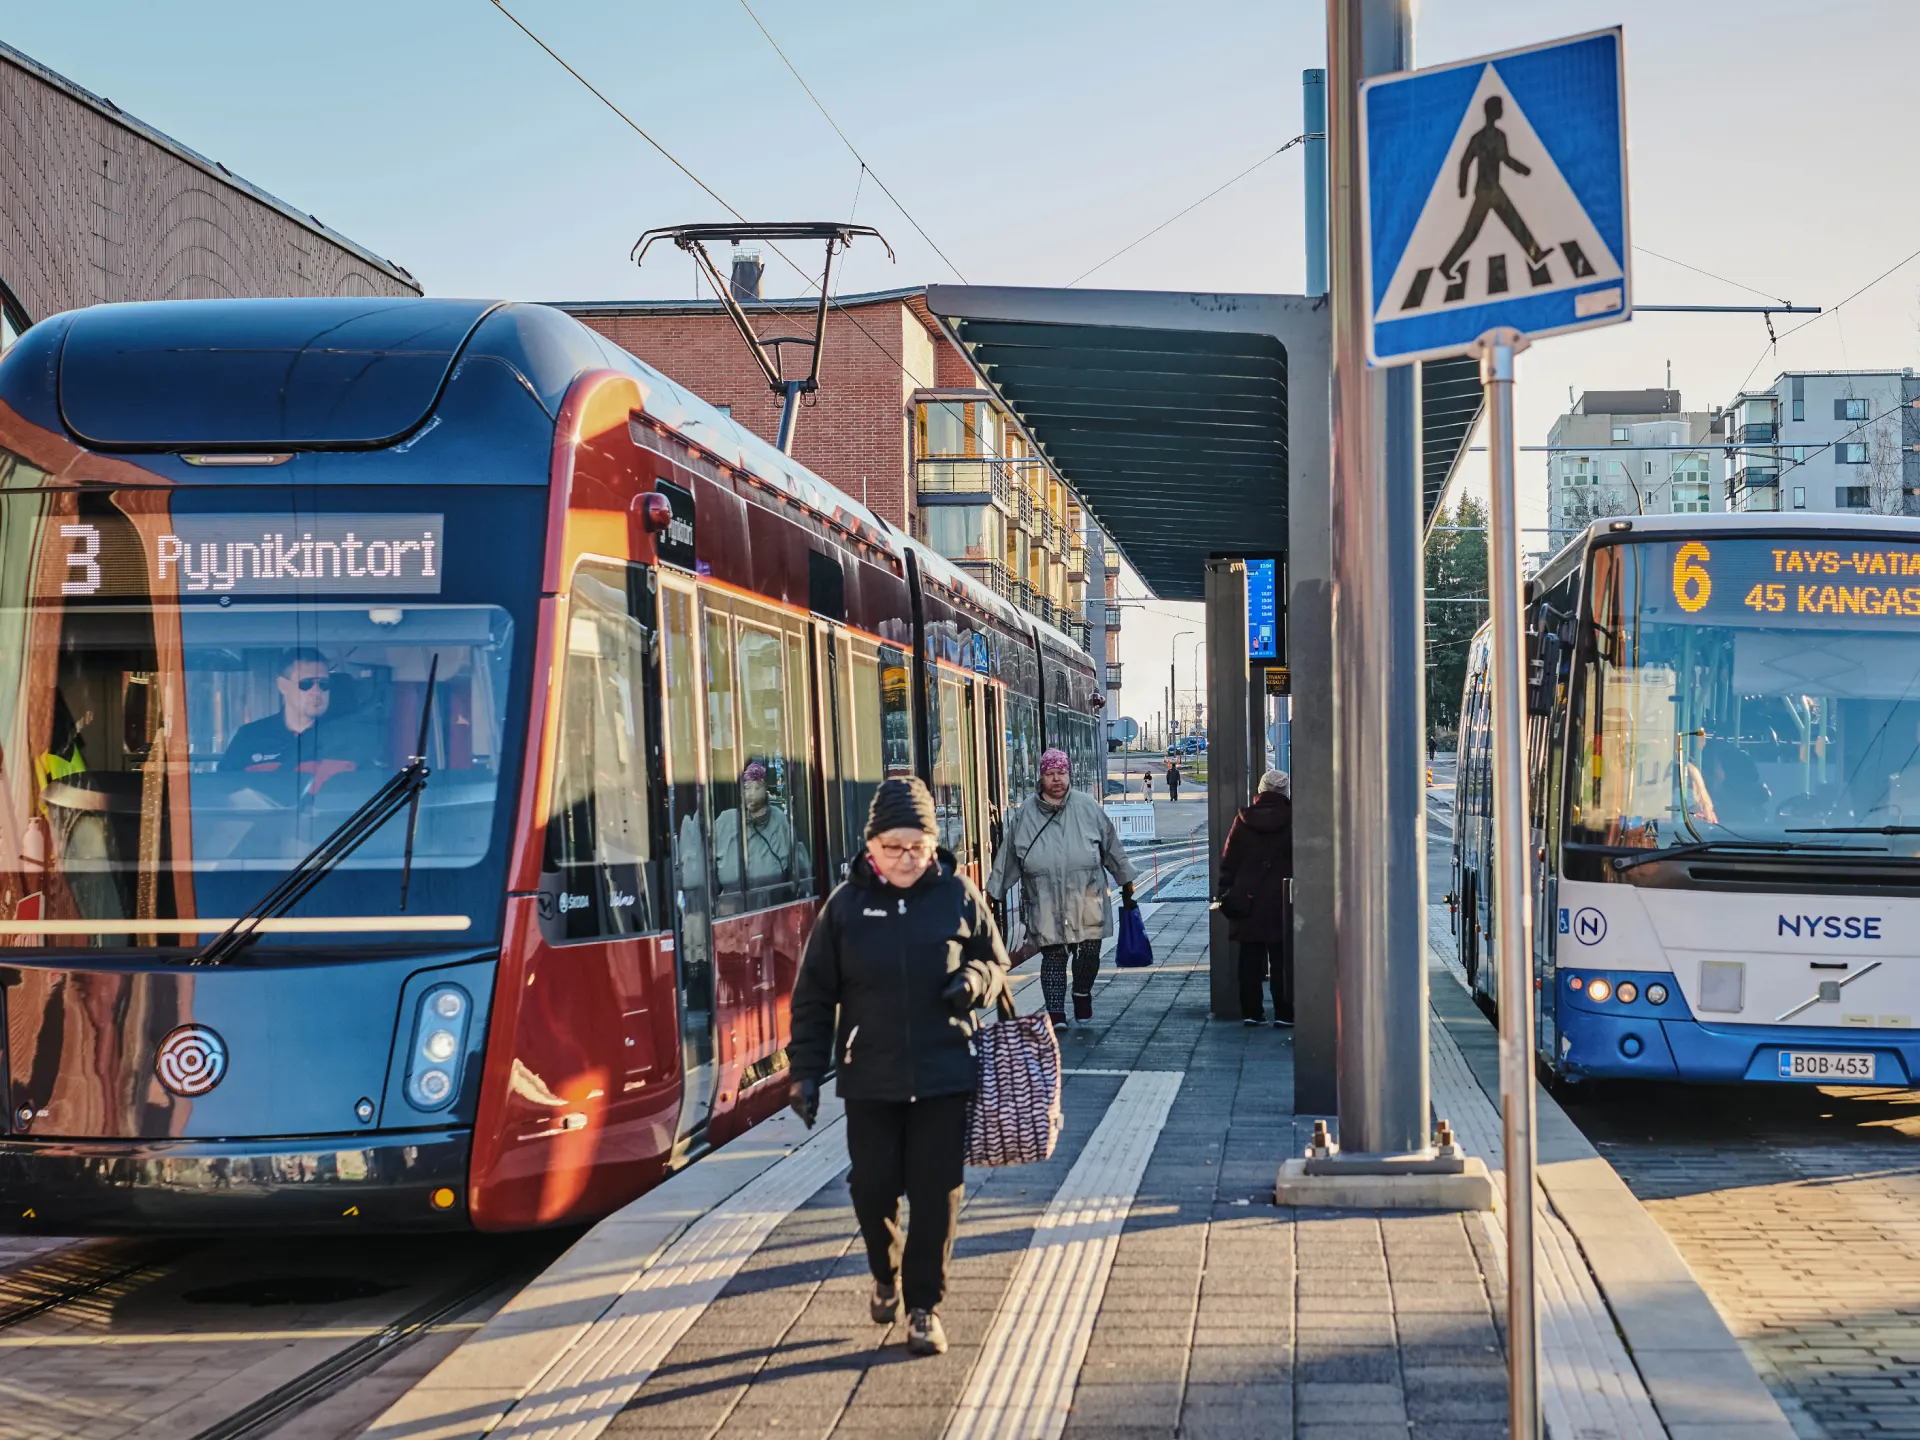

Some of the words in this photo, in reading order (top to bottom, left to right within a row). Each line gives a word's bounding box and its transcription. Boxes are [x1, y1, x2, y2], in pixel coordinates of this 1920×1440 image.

[61, 523, 100, 594] 3
[157, 531, 436, 590] Pyynikintori
[1771, 550, 1920, 575] TAYS-VATIA
[1673, 541, 1712, 612] 6
[1745, 583, 1786, 612] 45
[1797, 585, 1920, 616] KANGAS
[1778, 914, 1882, 939] NYSSE
